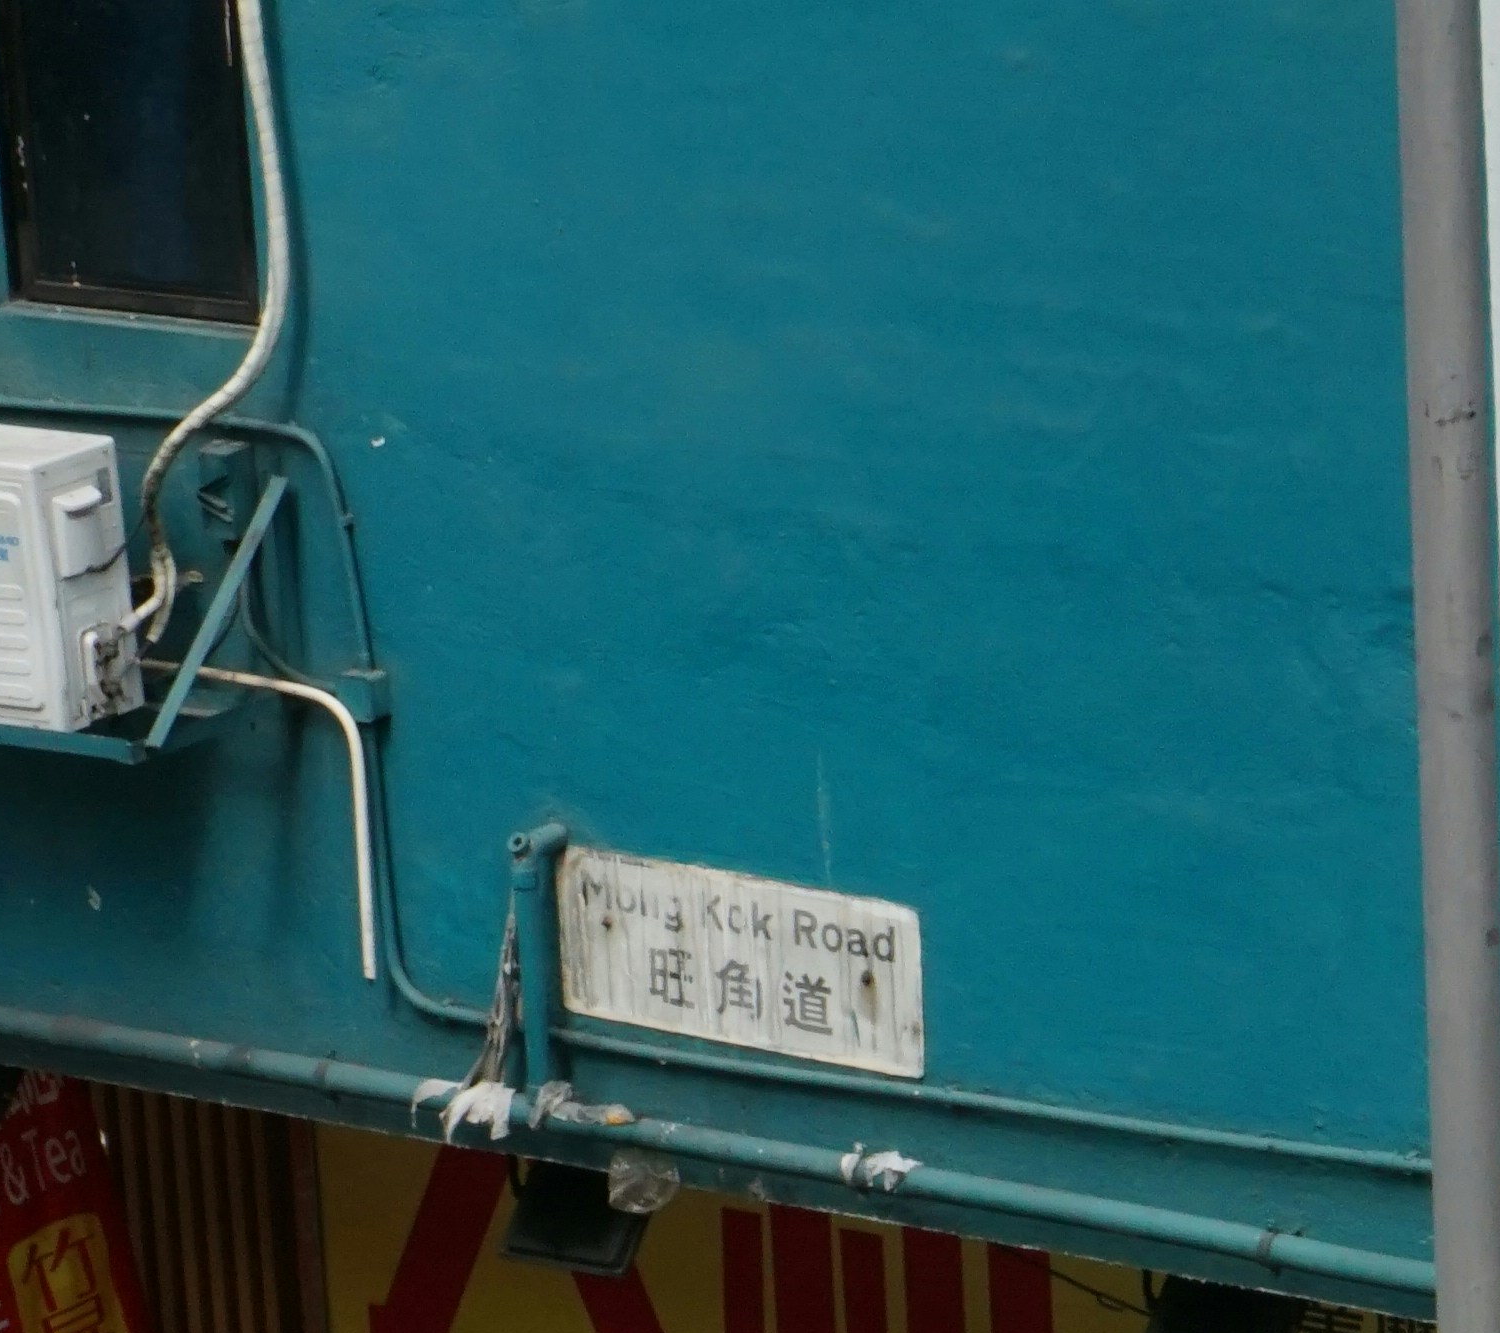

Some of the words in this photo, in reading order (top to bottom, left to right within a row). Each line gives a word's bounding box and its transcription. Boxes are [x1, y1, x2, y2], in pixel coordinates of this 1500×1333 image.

[793, 908, 896, 962] Road
[648, 946, 833, 1037] 旺角道
[2, 1149, 30, 1218] &
[30, 1126, 87, 1202] Tea
